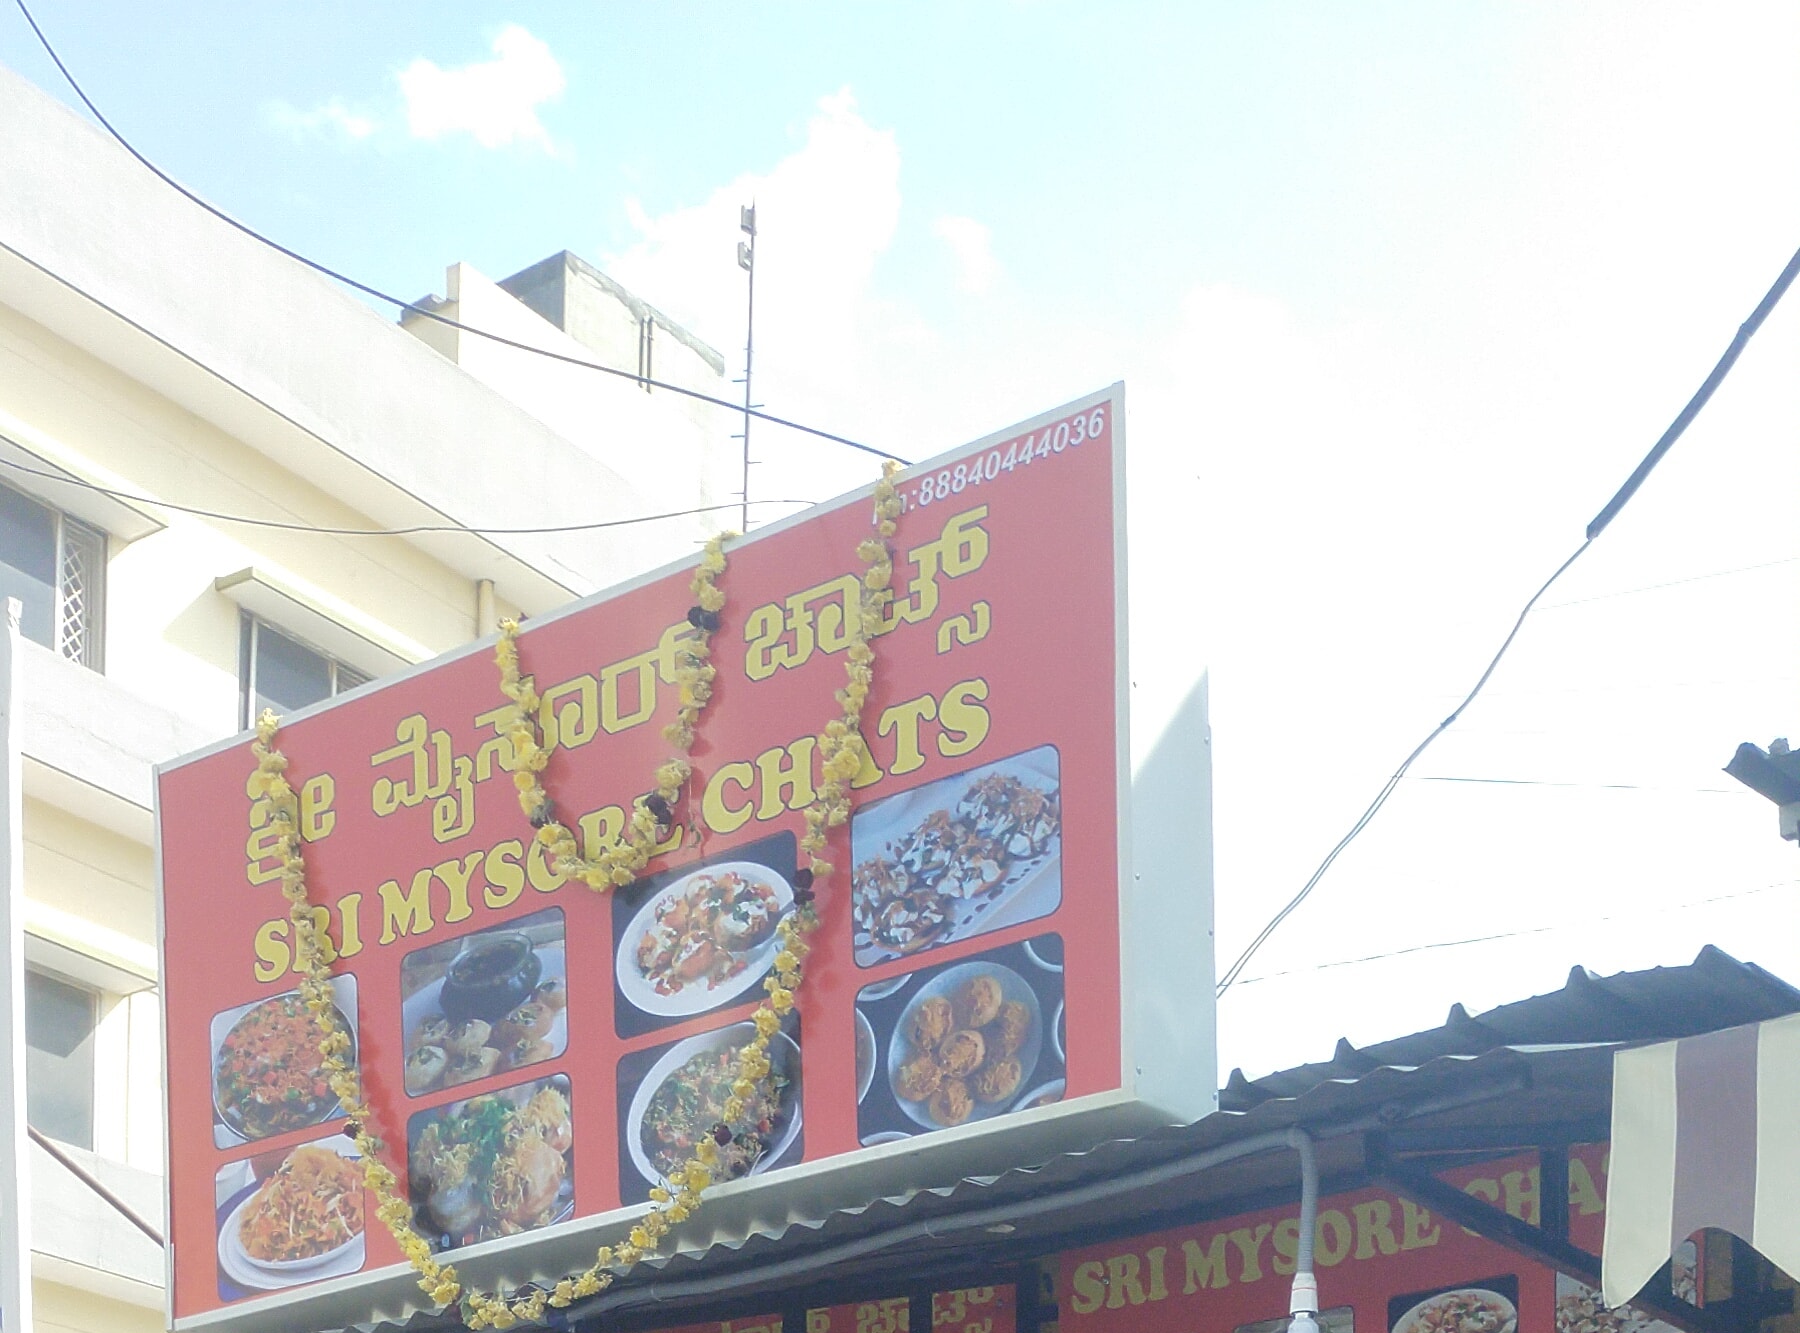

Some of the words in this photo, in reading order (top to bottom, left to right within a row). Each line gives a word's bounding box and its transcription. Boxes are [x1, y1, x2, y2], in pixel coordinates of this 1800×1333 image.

[872, 408, 1104, 525] :88840444036
[254, 892, 364, 984] SRI
[378, 789, 683, 946] MYSORE
[1072, 1246, 1169, 1314] SRI
[1181, 1197, 1440, 1295] MYSORE
[1460, 1154, 1610, 1237] HA
